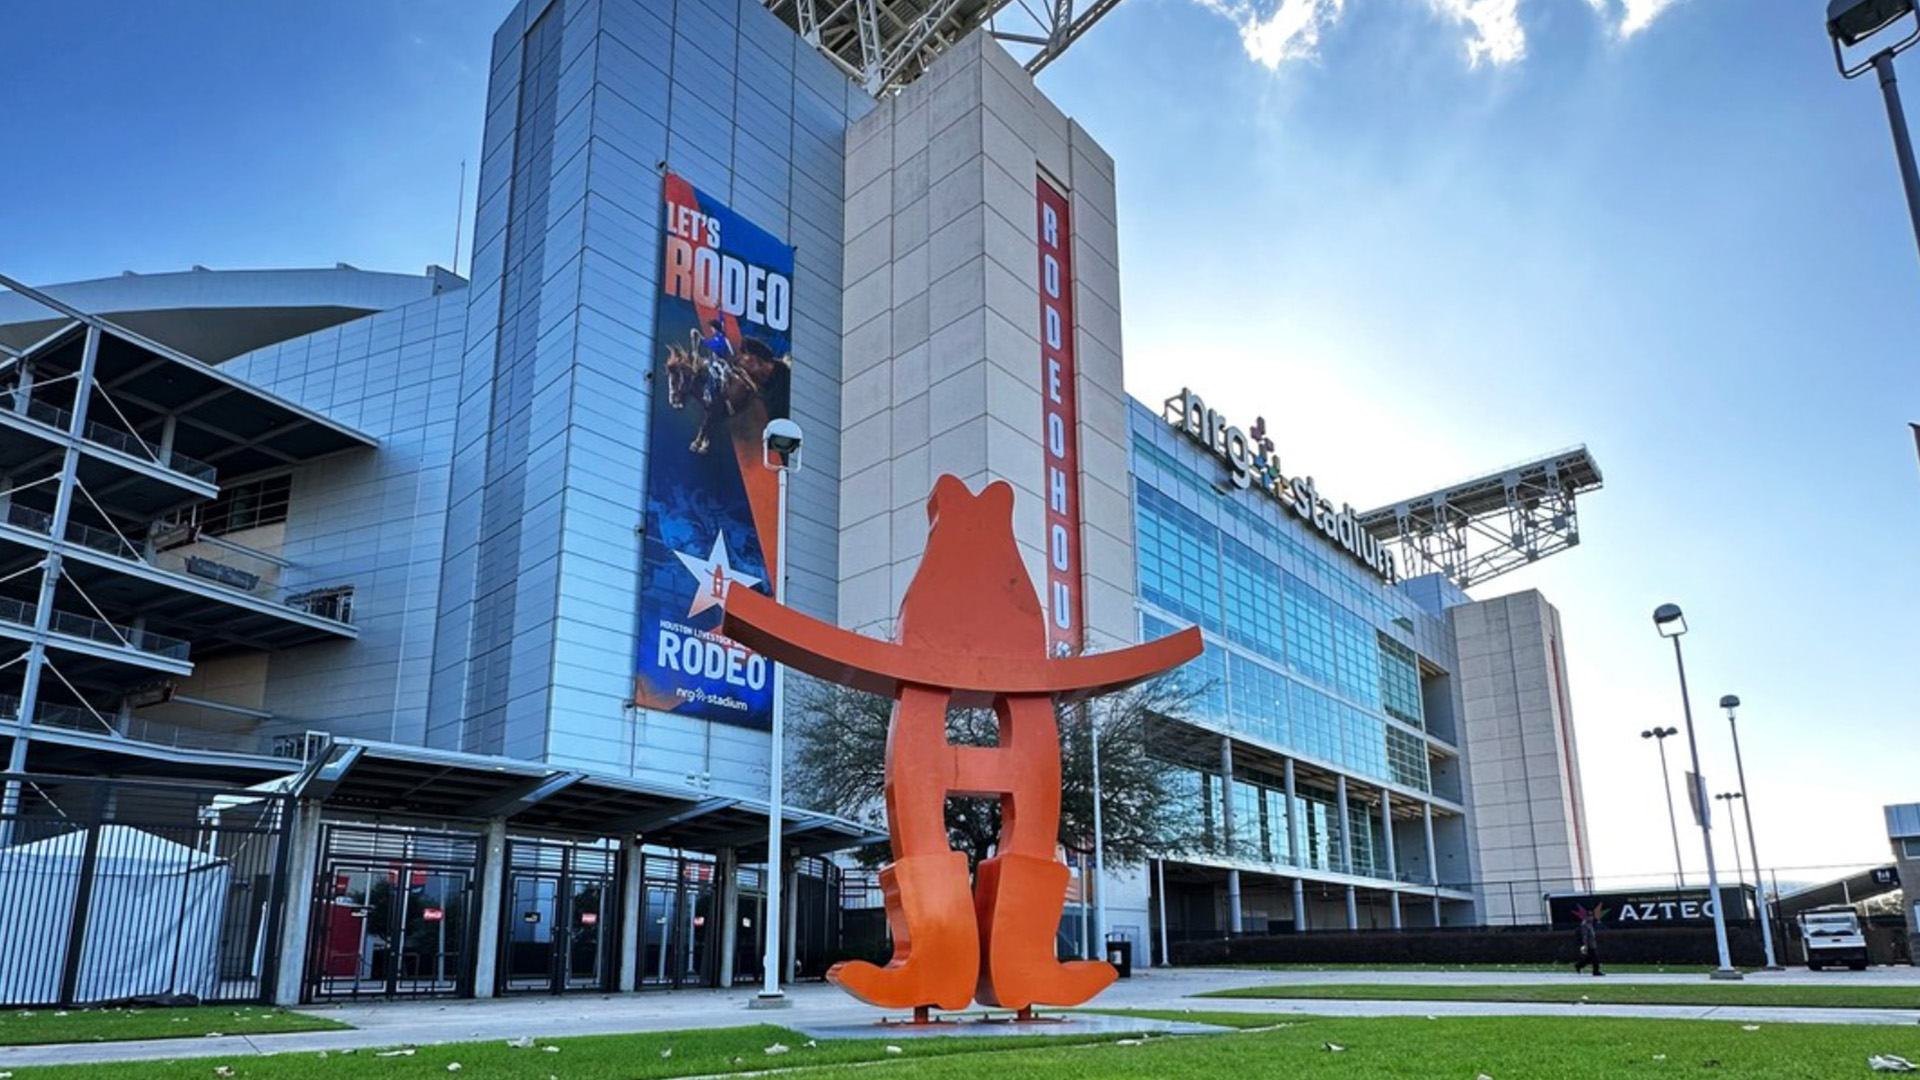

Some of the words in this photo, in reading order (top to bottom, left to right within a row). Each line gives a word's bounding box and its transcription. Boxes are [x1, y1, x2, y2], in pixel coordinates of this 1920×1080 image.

[666, 201, 721, 249] LET'S
[664, 235, 790, 332] RODEO
[1182, 387, 1251, 490] nrg
[1290, 475, 1399, 586] stadium
[660, 619, 693, 635] HOUSTON
[657, 629, 766, 691] RODEO
[676, 687, 695, 703] nrg
[707, 693, 748, 711] stadium
[1619, 900, 1715, 920] AZTEC
